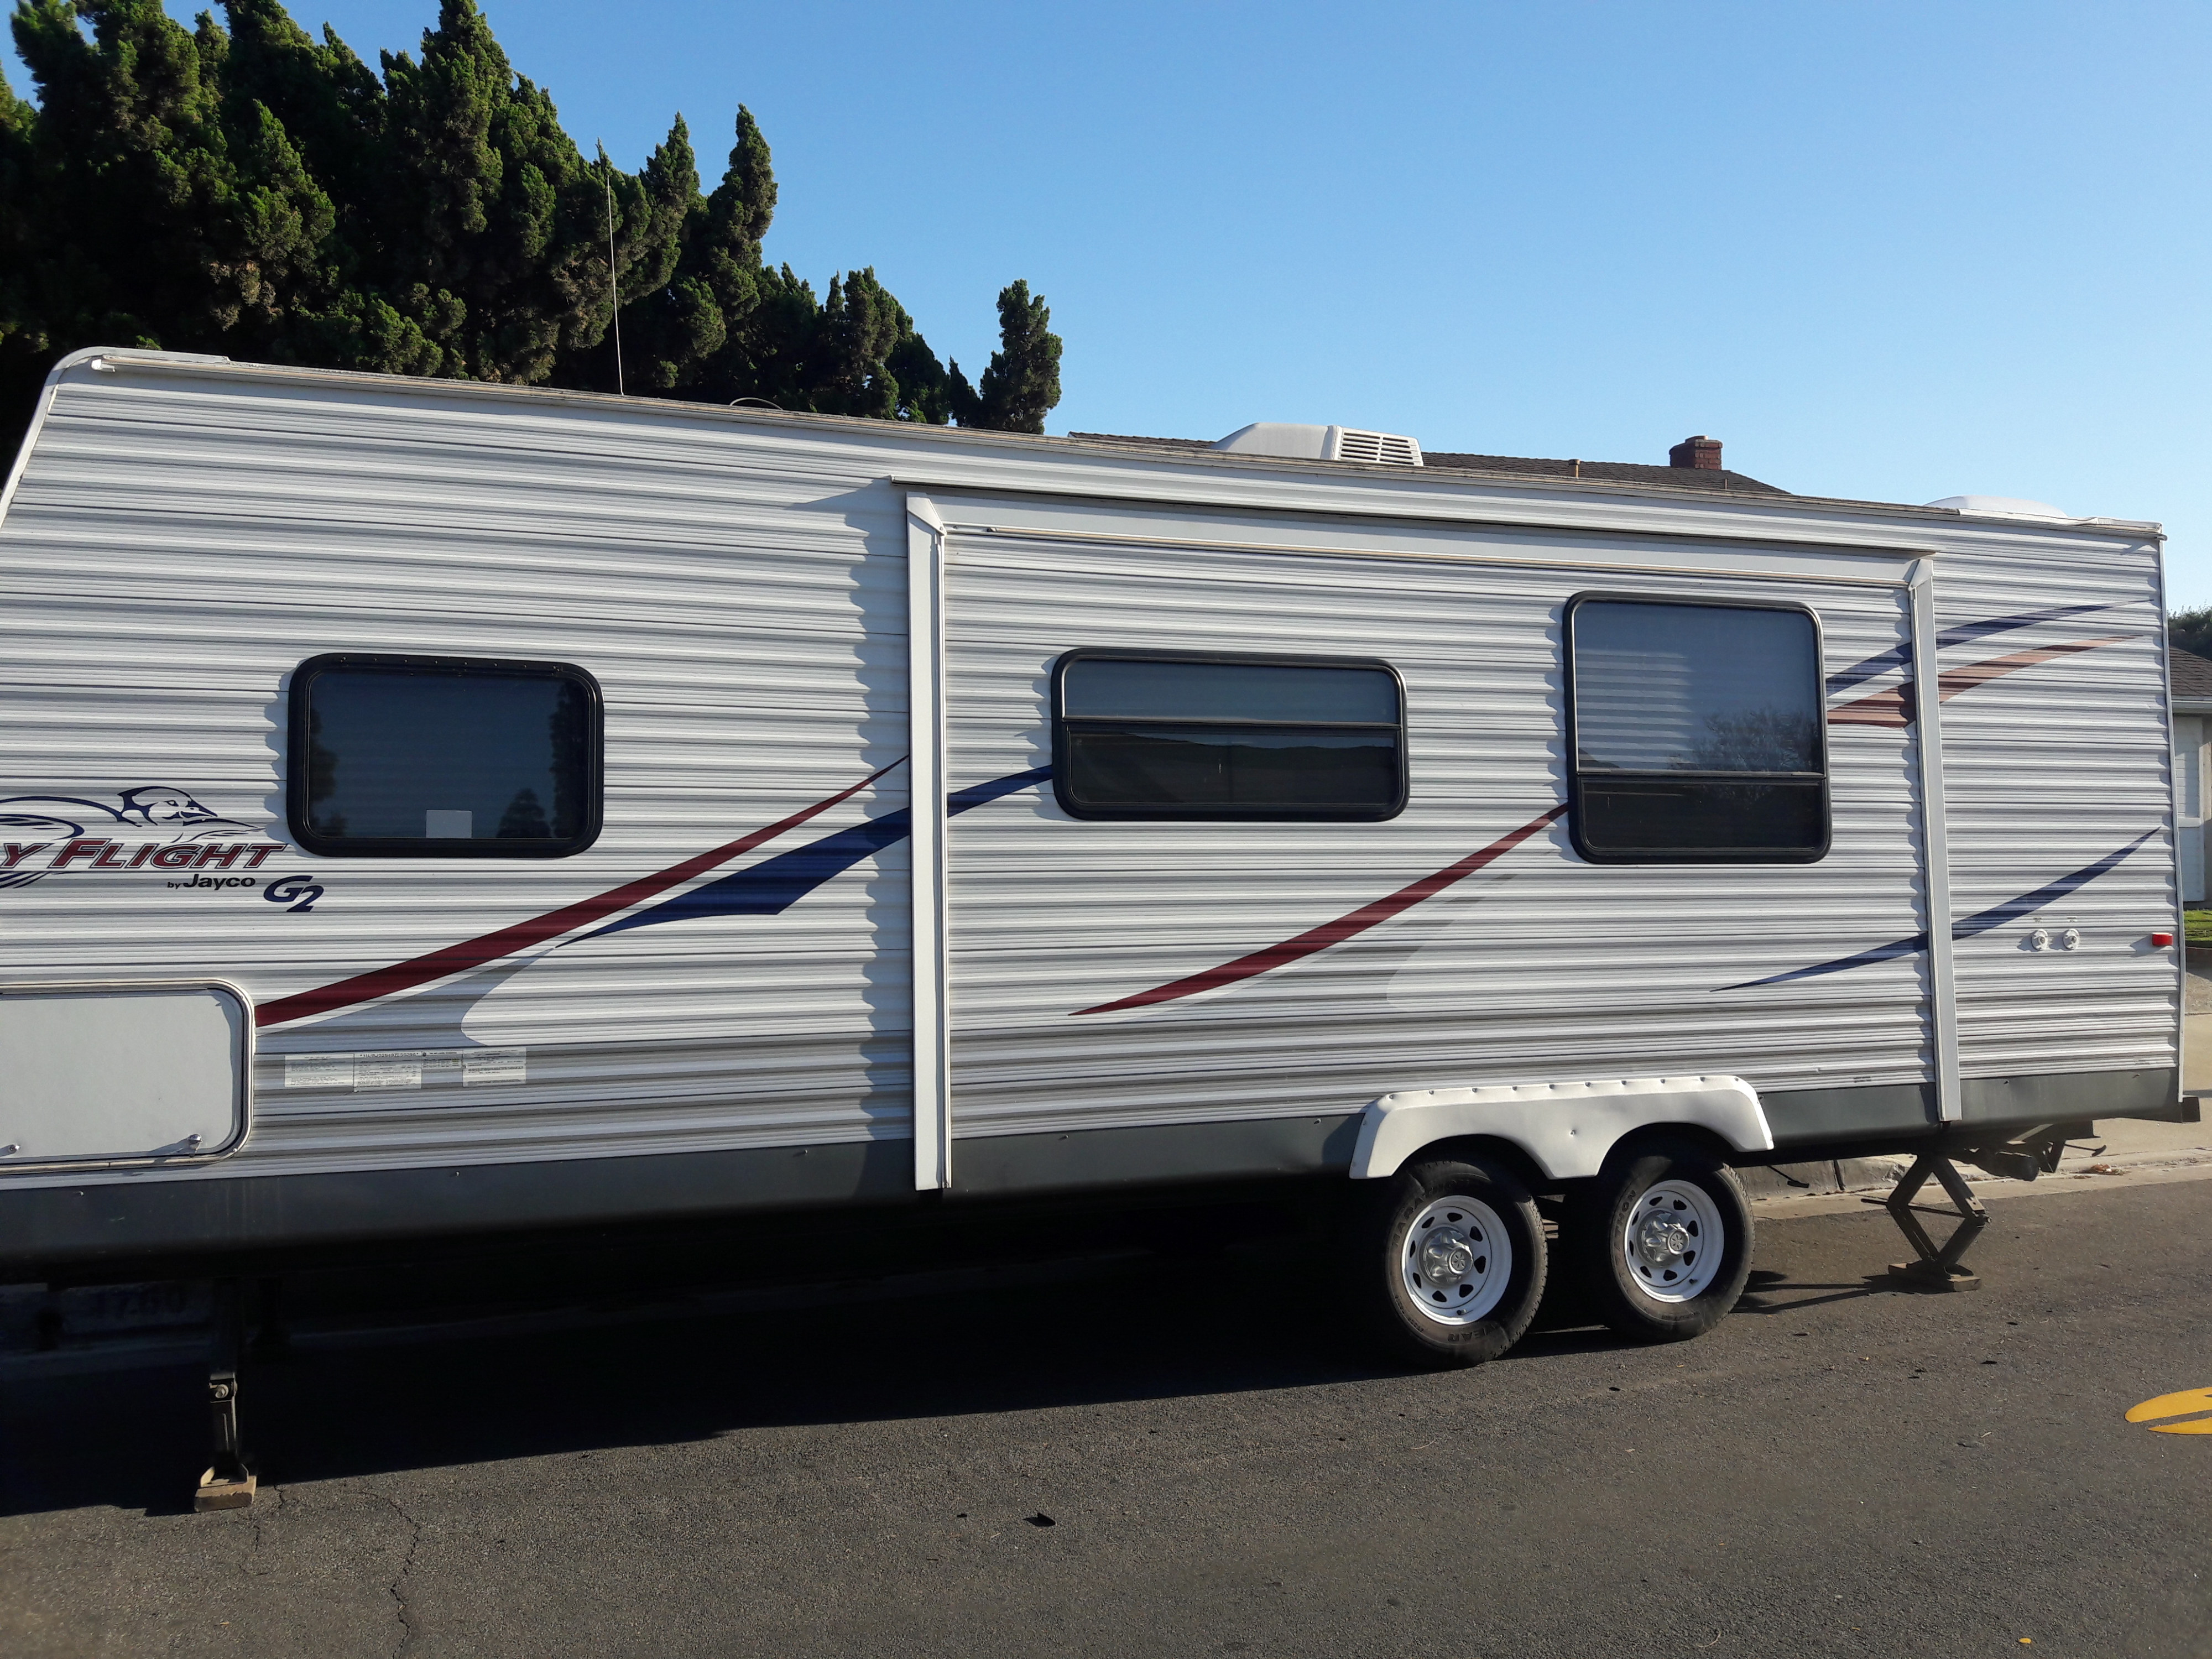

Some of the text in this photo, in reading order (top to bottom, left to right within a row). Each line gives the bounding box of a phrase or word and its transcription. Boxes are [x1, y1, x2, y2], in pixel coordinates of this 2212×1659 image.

[46, 838, 288, 869] FLIGHT
[182, 873, 255, 890] Jayco
[263, 875, 324, 912] G2
